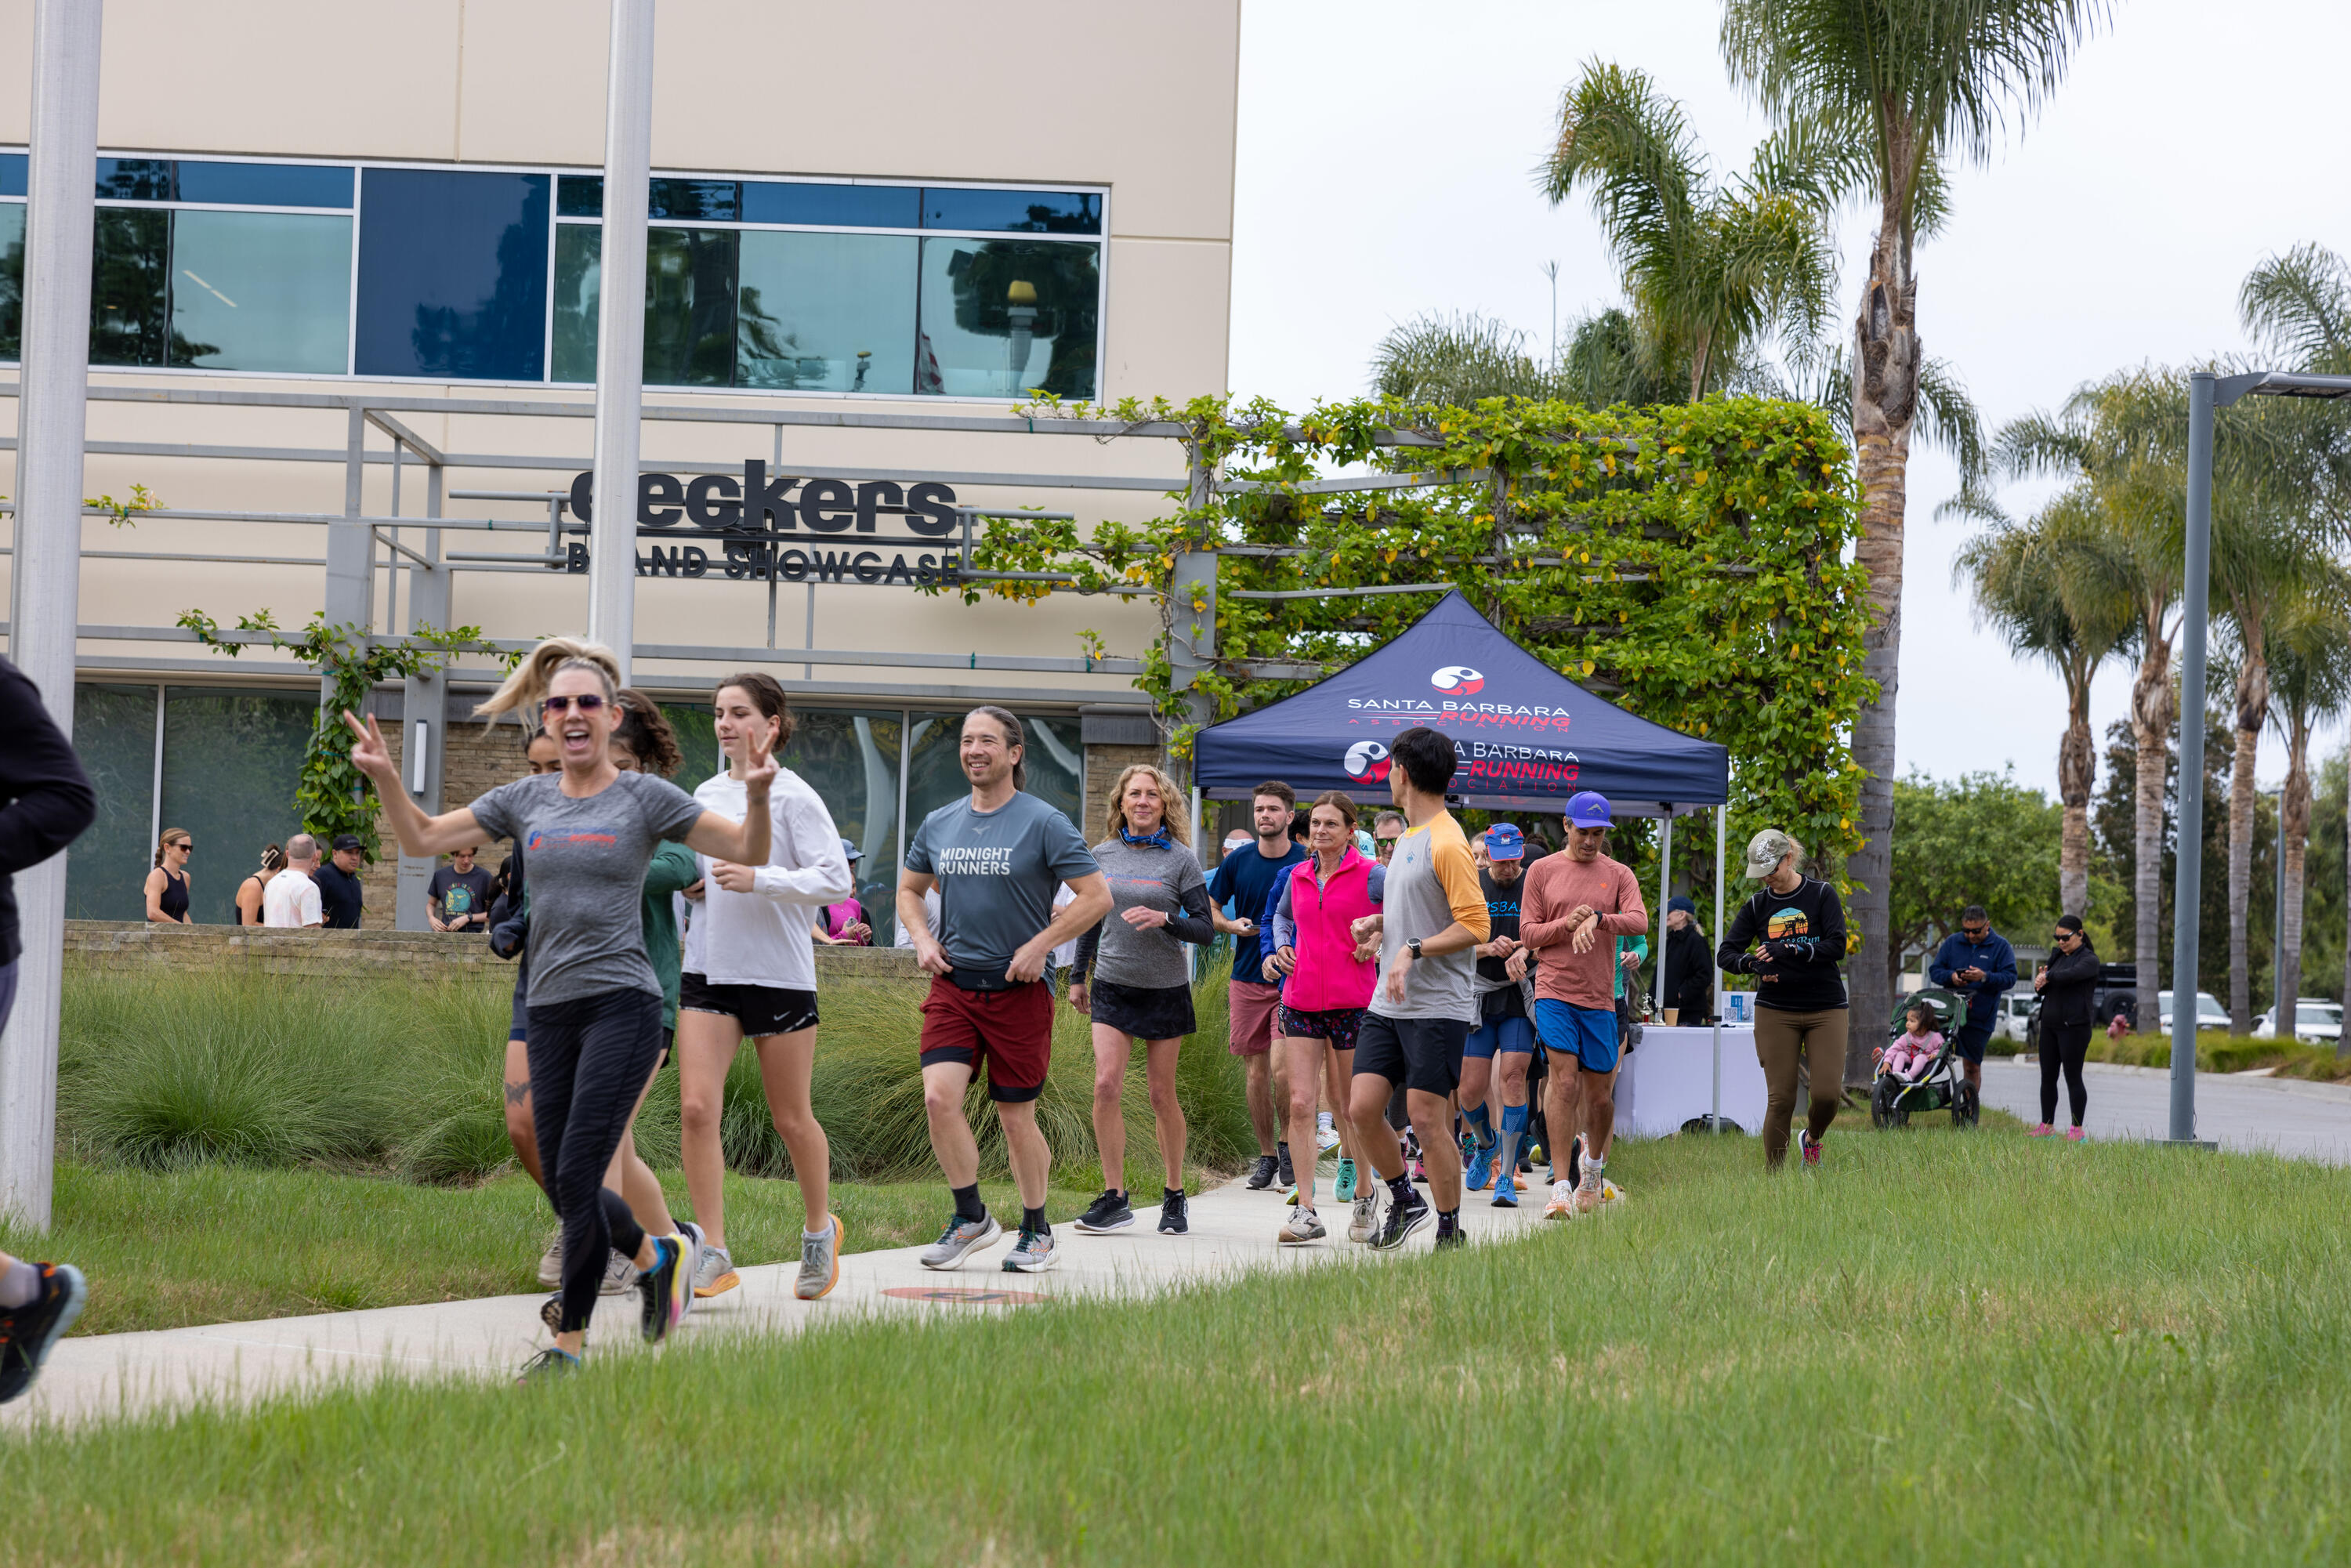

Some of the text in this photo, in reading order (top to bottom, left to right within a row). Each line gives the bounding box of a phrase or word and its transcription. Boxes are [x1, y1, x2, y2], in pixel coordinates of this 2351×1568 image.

[567, 542, 959, 586] BND SHOWCASE
[1348, 698, 1570, 717] SANTA BARBARA
[1348, 719, 1568, 733] ASSOCIATION
[1439, 711, 1571, 727] RUNNING
[1473, 741, 1580, 762] BARBARA
[1469, 760, 1581, 780] RUNNING
[1447, 777, 1577, 792] OCIATION
[940, 847, 1013, 861] MIDNIGHT
[938, 861, 1011, 876] RUNNERS
